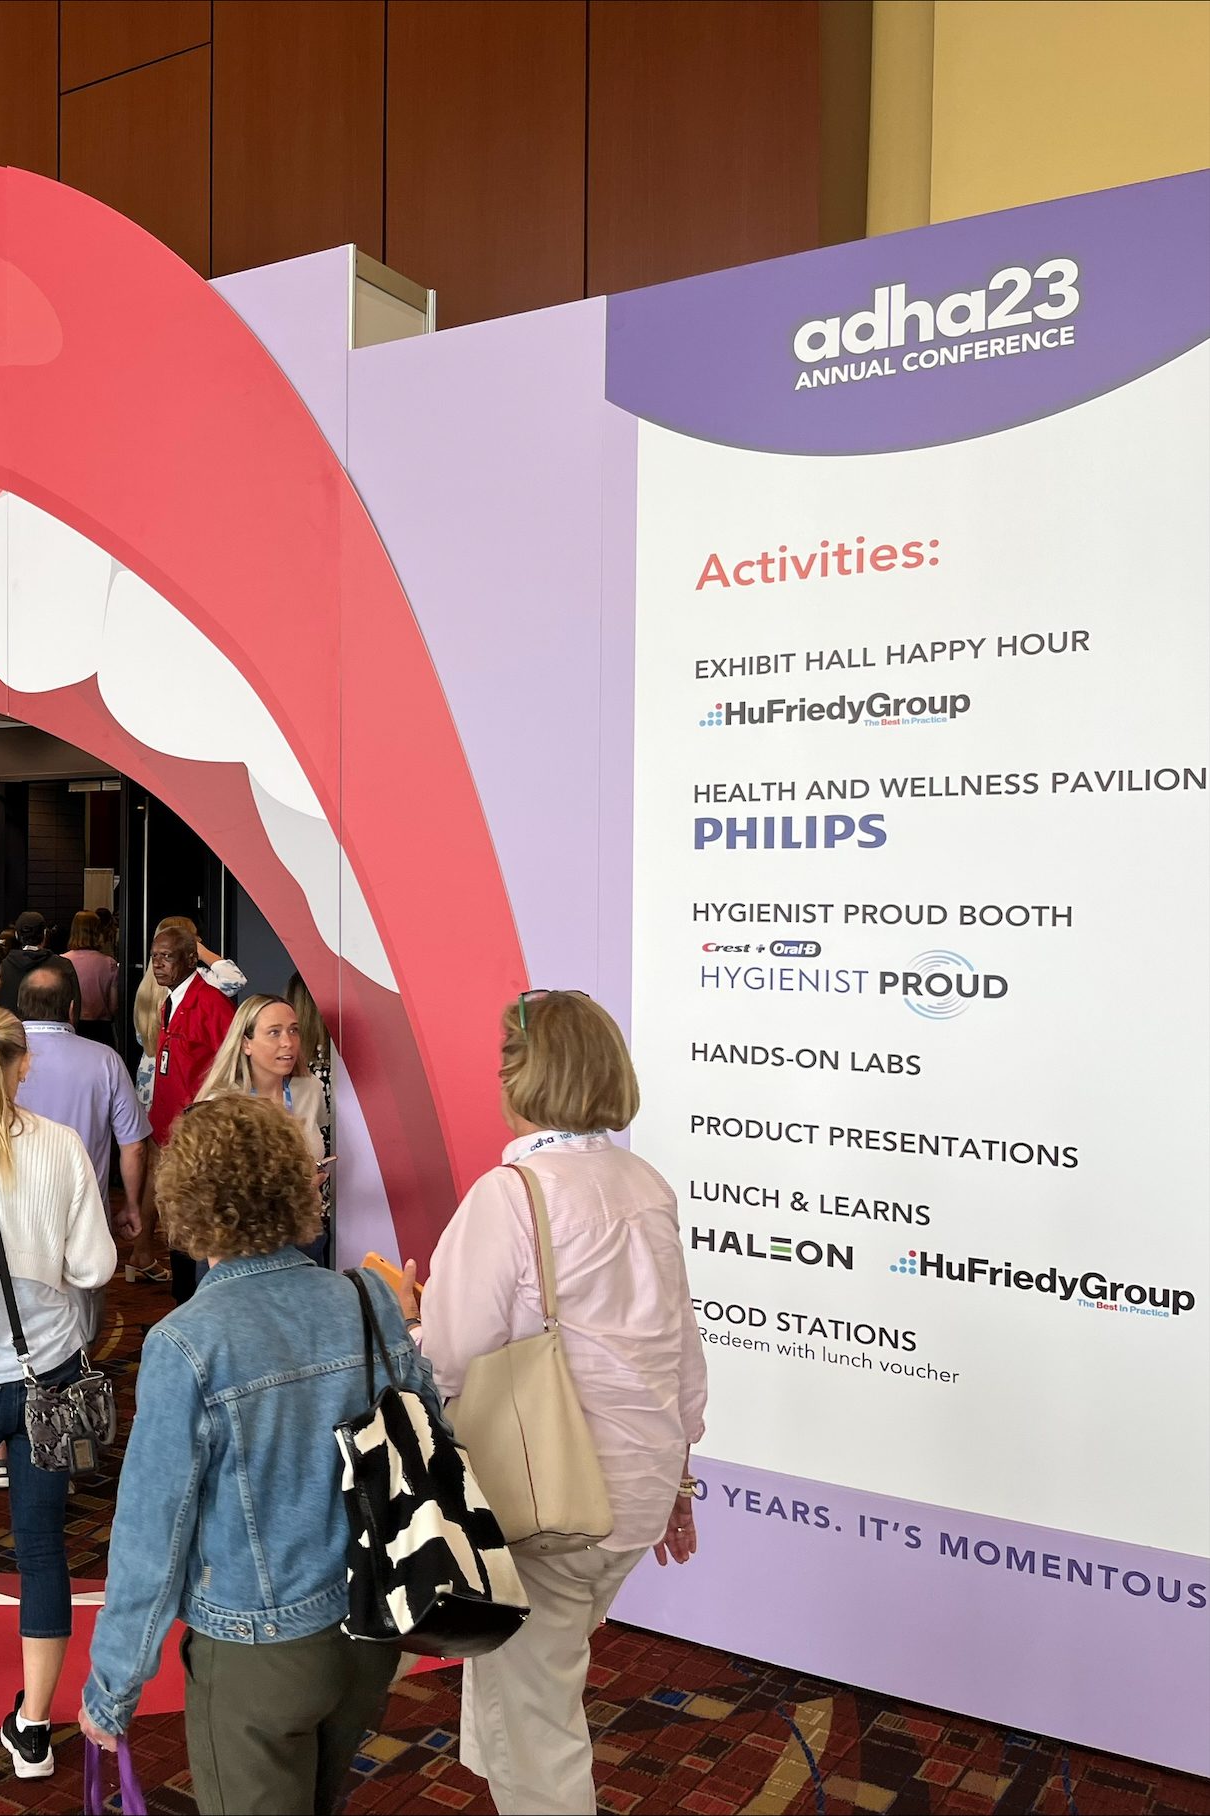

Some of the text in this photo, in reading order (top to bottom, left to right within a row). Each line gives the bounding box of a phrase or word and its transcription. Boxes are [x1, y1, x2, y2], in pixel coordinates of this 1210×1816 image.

[793, 258, 1080, 363] adha23
[794, 326, 1075, 390] ANNUAL CONFERENCE
[695, 536, 941, 590] Activities:
[694, 629, 1091, 679] EXHIBIT HALL HAPPY HOUR
[725, 693, 971, 725] HuFriedyGroup
[864, 716, 948, 727] The Best In Practice
[693, 767, 1208, 804] HEALTH AND WELLNESS PAVILION
[693, 814, 888, 850] PHILIPS
[692, 903, 1073, 928] HYGIENIST PROUD BOOTH
[702, 942, 751, 954] Crest
[773, 942, 818, 956] Oral-B
[701, 966, 1008, 999] HYGIENIST PROUD
[691, 1043, 921, 1076] HANDS-ON LABS
[530, 1136, 554, 1152] adha
[690, 1115, 1079, 1169] PRODUCT PRESENTATIONS
[690, 1180, 931, 1225] LUNCH & LEARNS
[691, 1226, 854, 1270] HALEON
[920, 1251, 1195, 1316] HuFriedyGroup
[691, 1298, 917, 1352] FOOD STATIONS
[1077, 1298, 1170, 1318] The Best In Practice
[699, 1327, 960, 1383] Redeem with lunch voucher
[722, 1484, 842, 1532] YEARS.
[859, 1514, 922, 1550] IT'S
[940, 1532, 1207, 1609] MOMENTOUS
